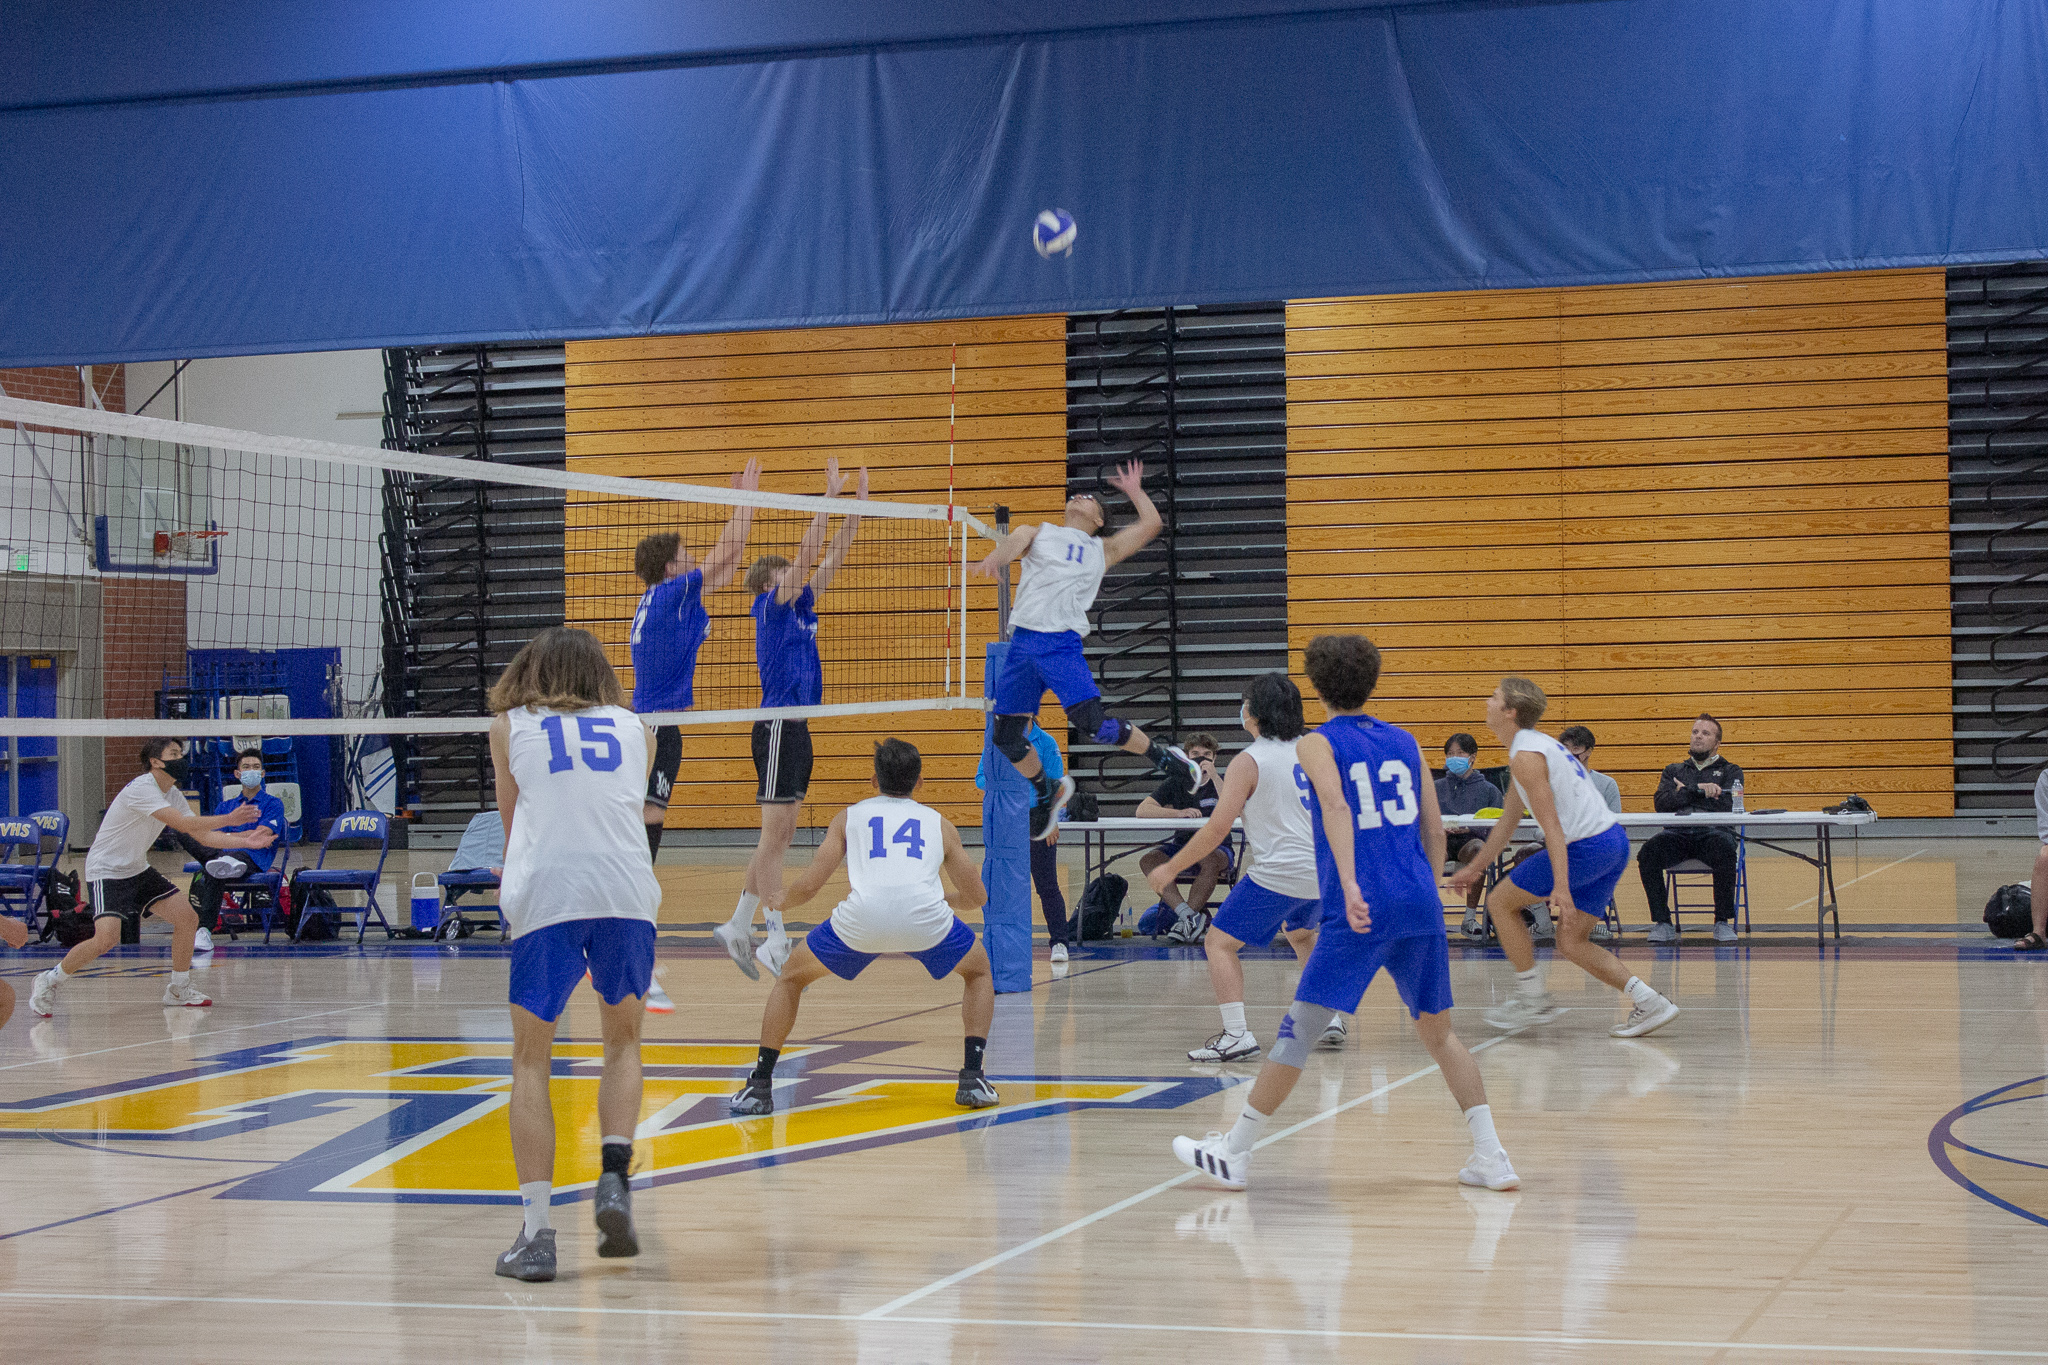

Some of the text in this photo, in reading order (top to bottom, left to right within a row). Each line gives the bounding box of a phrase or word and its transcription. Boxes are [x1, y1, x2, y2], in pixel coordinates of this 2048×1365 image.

[1066, 543, 1084, 565] 11
[540, 715, 623, 775] 15
[1349, 759, 1419, 830] 13
[340, 815, 379, 833] FVHS
[868, 816, 926, 860] 14
